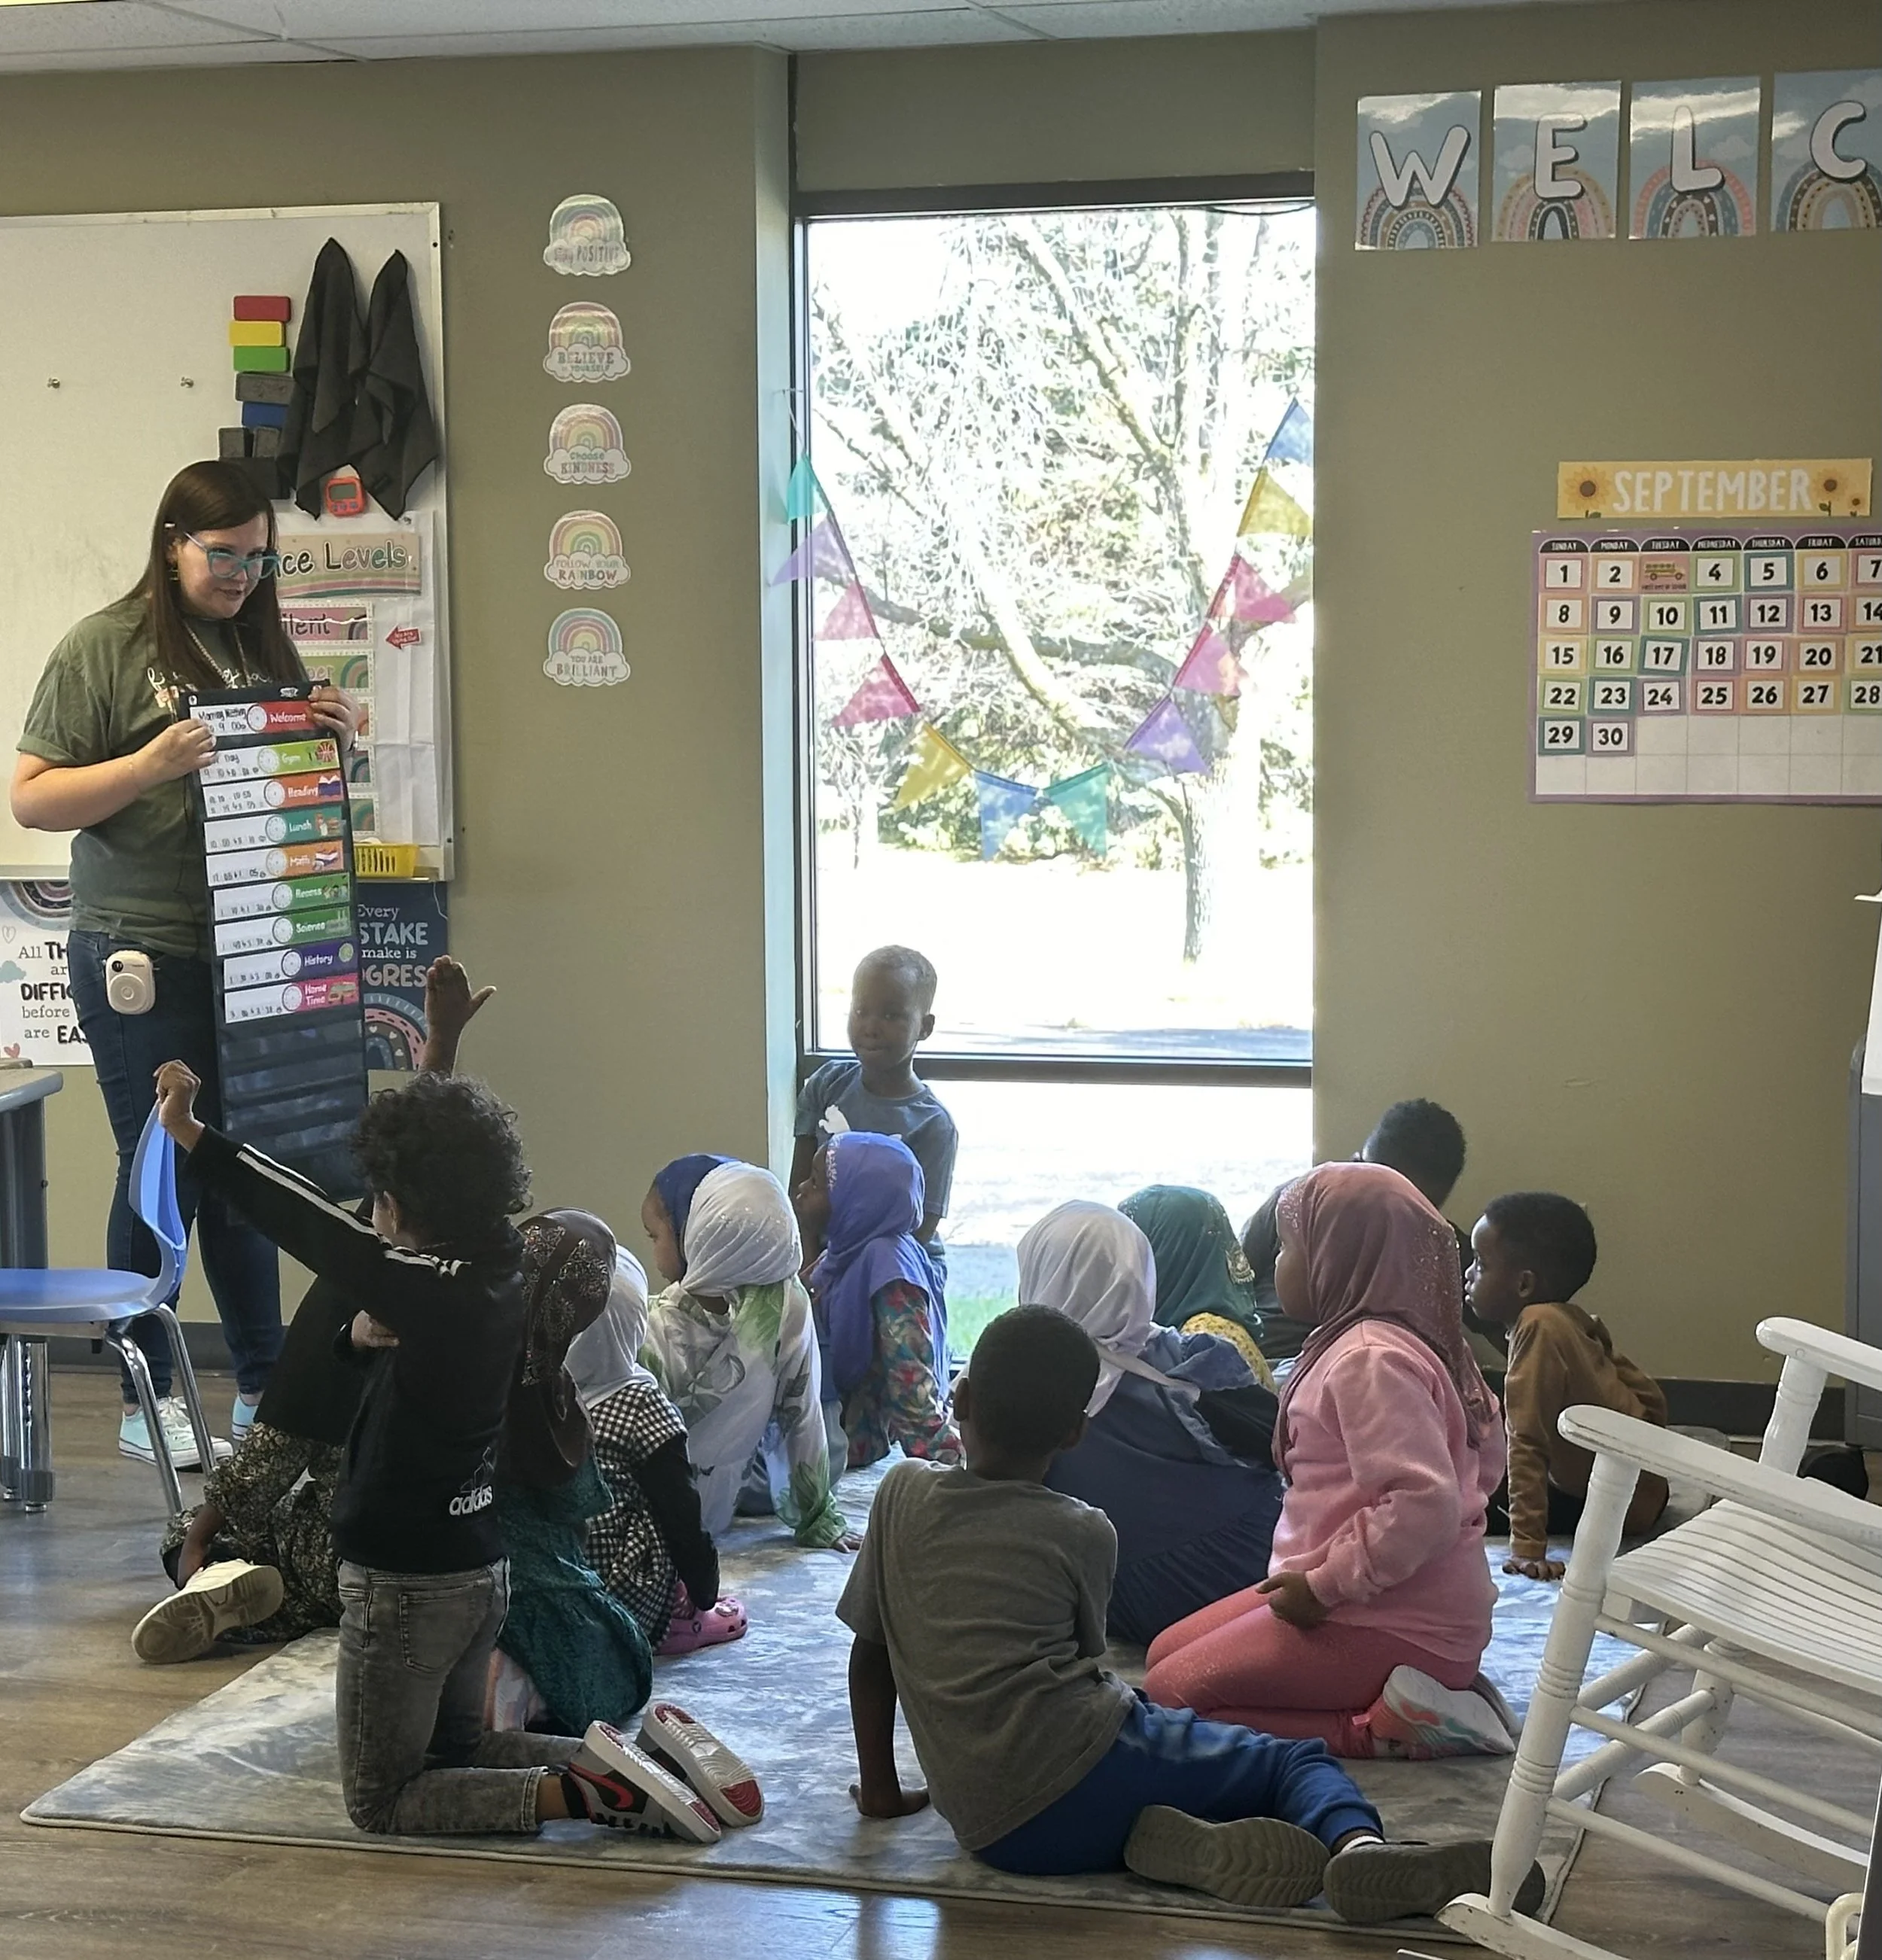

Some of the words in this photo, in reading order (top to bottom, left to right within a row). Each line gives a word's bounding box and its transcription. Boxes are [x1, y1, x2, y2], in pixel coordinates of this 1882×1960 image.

[558, 352, 614, 364] BELIEVE
[561, 462, 615, 474] KINDNESS
[1613, 469, 1812, 512] SEPTEMBER
[1600, 541, 1628, 550] MONDAY
[325, 542, 407, 571] Levels
[559, 569, 617, 580] RAINBOW
[1560, 565, 1568, 583] 1
[1609, 566, 1621, 583] 2
[1708, 563, 1722, 581] 4
[1762, 562, 1774, 581] 5
[1816, 562, 1829, 581] 6
[1870, 559, 1882, 579] 7
[1558, 604, 1570, 623] 8
[1609, 605, 1621, 625] 9
[1657, 607, 1679, 625] 10
[1710, 605, 1727, 624] 11
[1757, 604, 1780, 623] 12
[1810, 603, 1832, 622] 13
[1862, 601, 1882, 621] 14
[1552, 646, 1574, 665] 15
[1603, 646, 1624, 665] 16
[1653, 647, 1674, 665] 17
[1705, 646, 1726, 665] 18
[1753, 645, 1776, 665] 19
[1804, 647, 1832, 666] 20
[1860, 645, 1882, 664] 21
[556, 663, 617, 677] BRILLIANT
[1549, 687, 1576, 705] 22
[1600, 687, 1626, 705] 23
[1647, 687, 1673, 706] 24
[1701, 686, 1727, 705] 25
[1752, 686, 1778, 705] 26
[1802, 684, 1829, 704] 27
[1854, 685, 1880, 705] 28
[270, 711, 307, 723] Welcome
[1548, 726, 1573, 744] 29
[1598, 727, 1623, 746] 30
[288, 786, 318, 798] Reading
[289, 819, 312, 832] Lunch
[358, 904, 400, 921] Every
[296, 921, 325, 933] Science
[18, 946, 43, 959] All
[361, 946, 402, 958] make
[406, 948, 417, 959] is
[304, 954, 333, 966] History
[362, 963, 428, 988] GRES
[304, 983, 327, 995] Home
[306, 995, 325, 1006] Time
[22, 1005, 70, 1018] before
[24, 1028, 50, 1039] are
